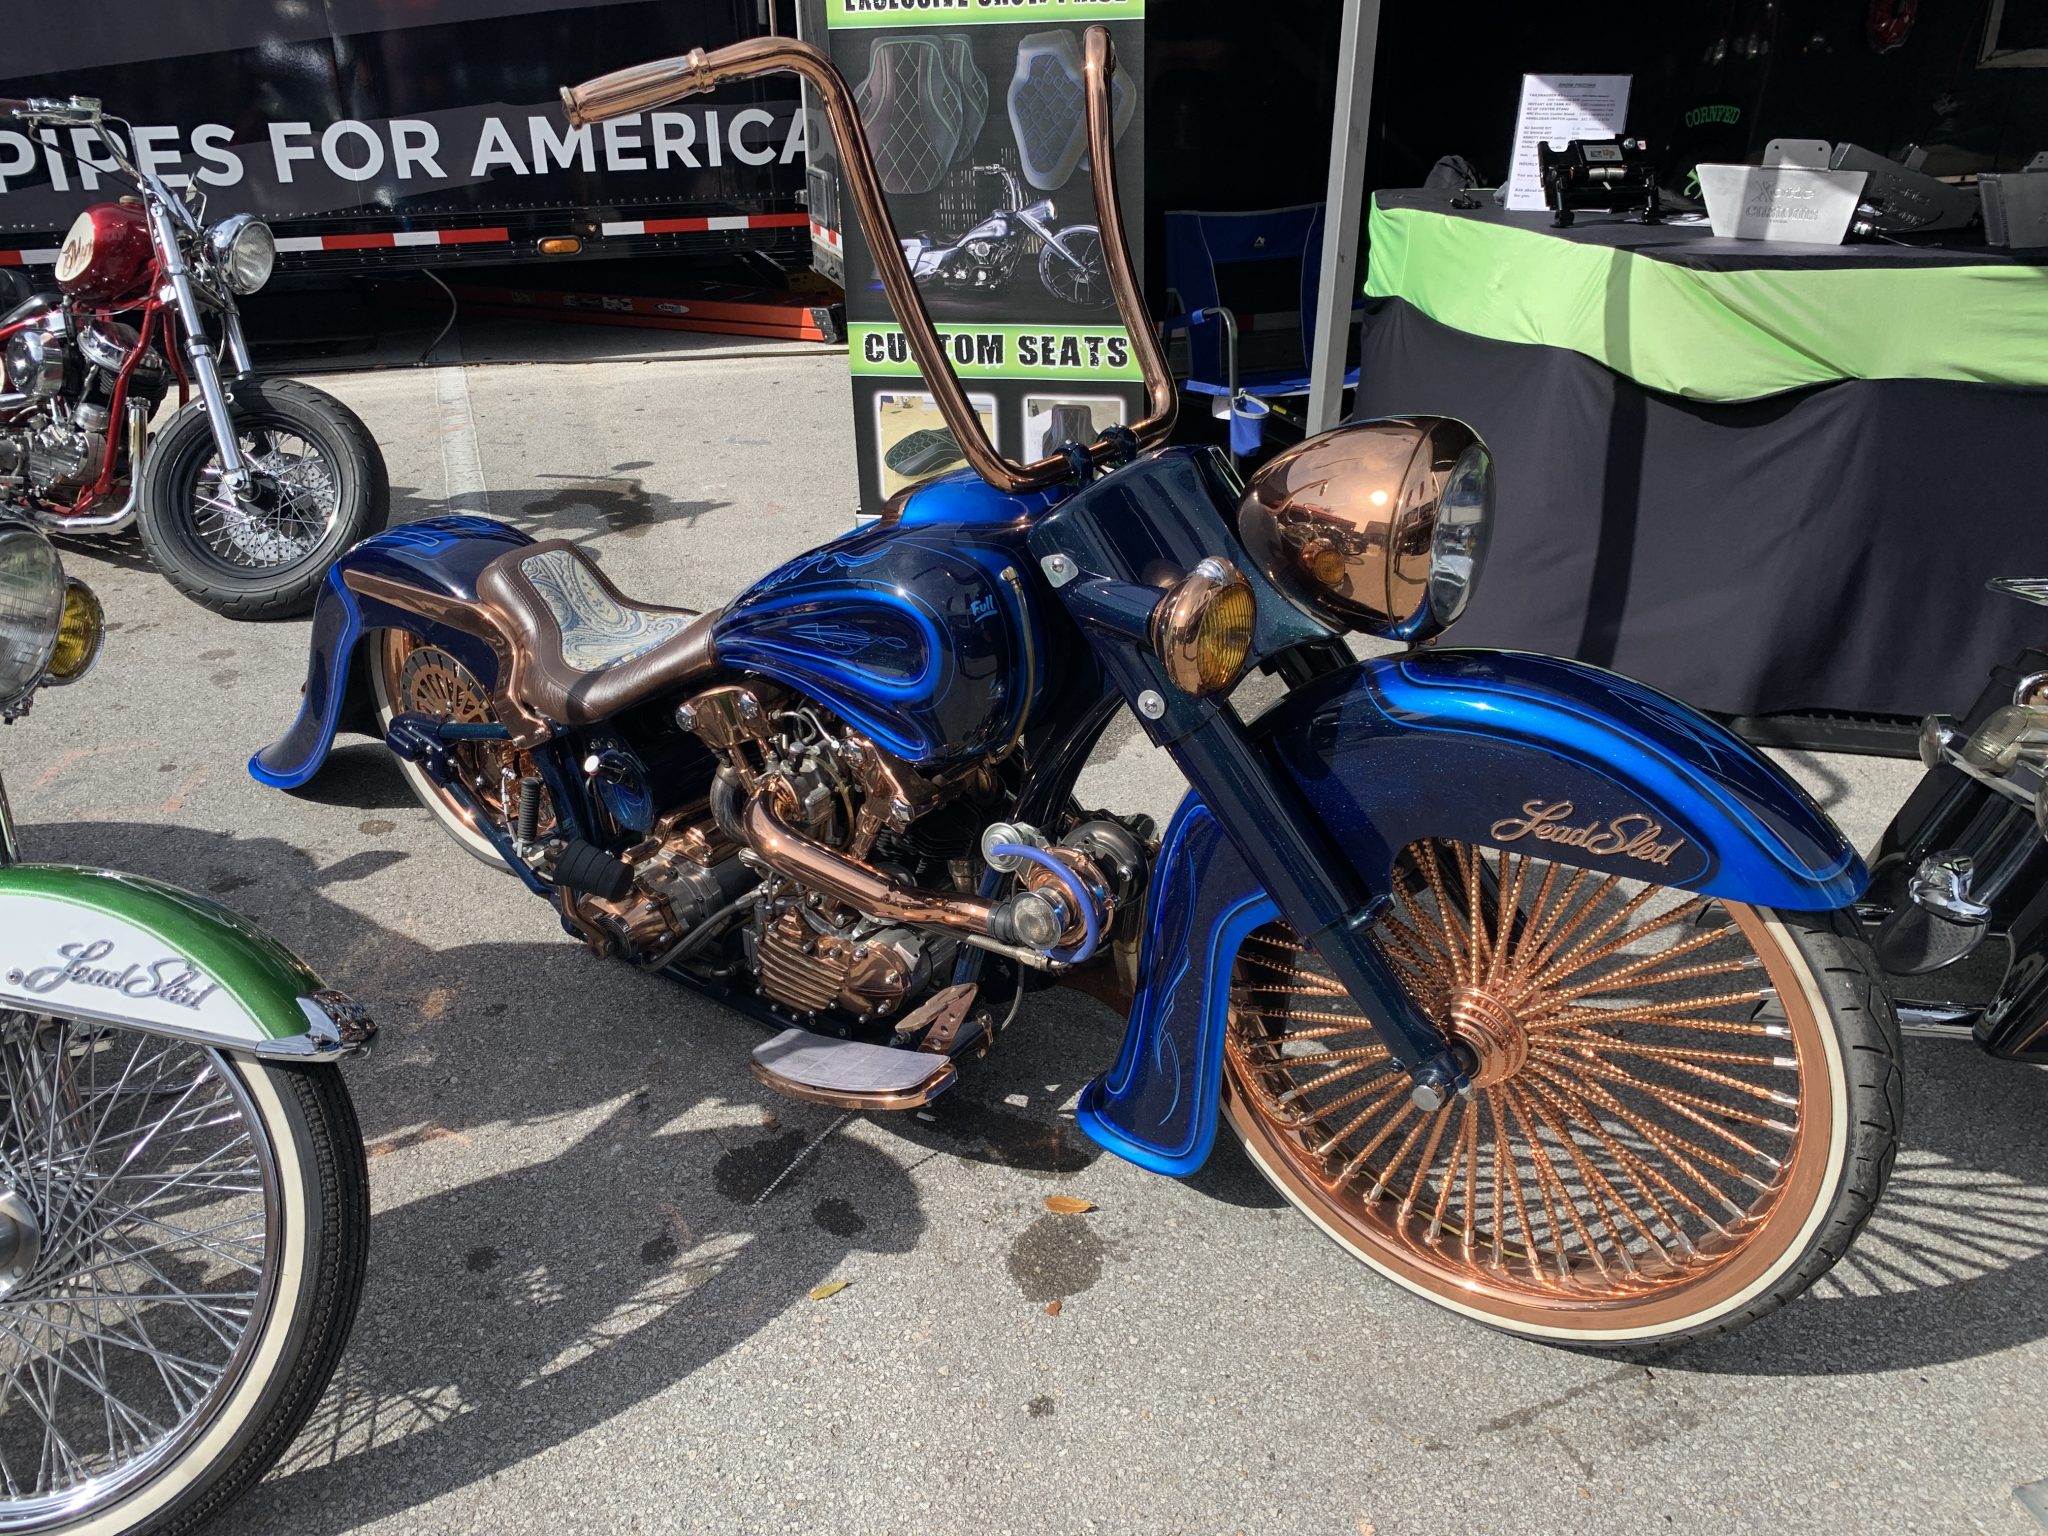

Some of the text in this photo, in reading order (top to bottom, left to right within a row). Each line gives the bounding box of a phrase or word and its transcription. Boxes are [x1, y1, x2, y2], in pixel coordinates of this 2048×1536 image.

[1685, 104, 1741, 128] CORNFED
[268, 118, 448, 184] FOR
[864, 332, 1129, 368] CUTOM SEATS
[970, 594, 995, 617] Full
